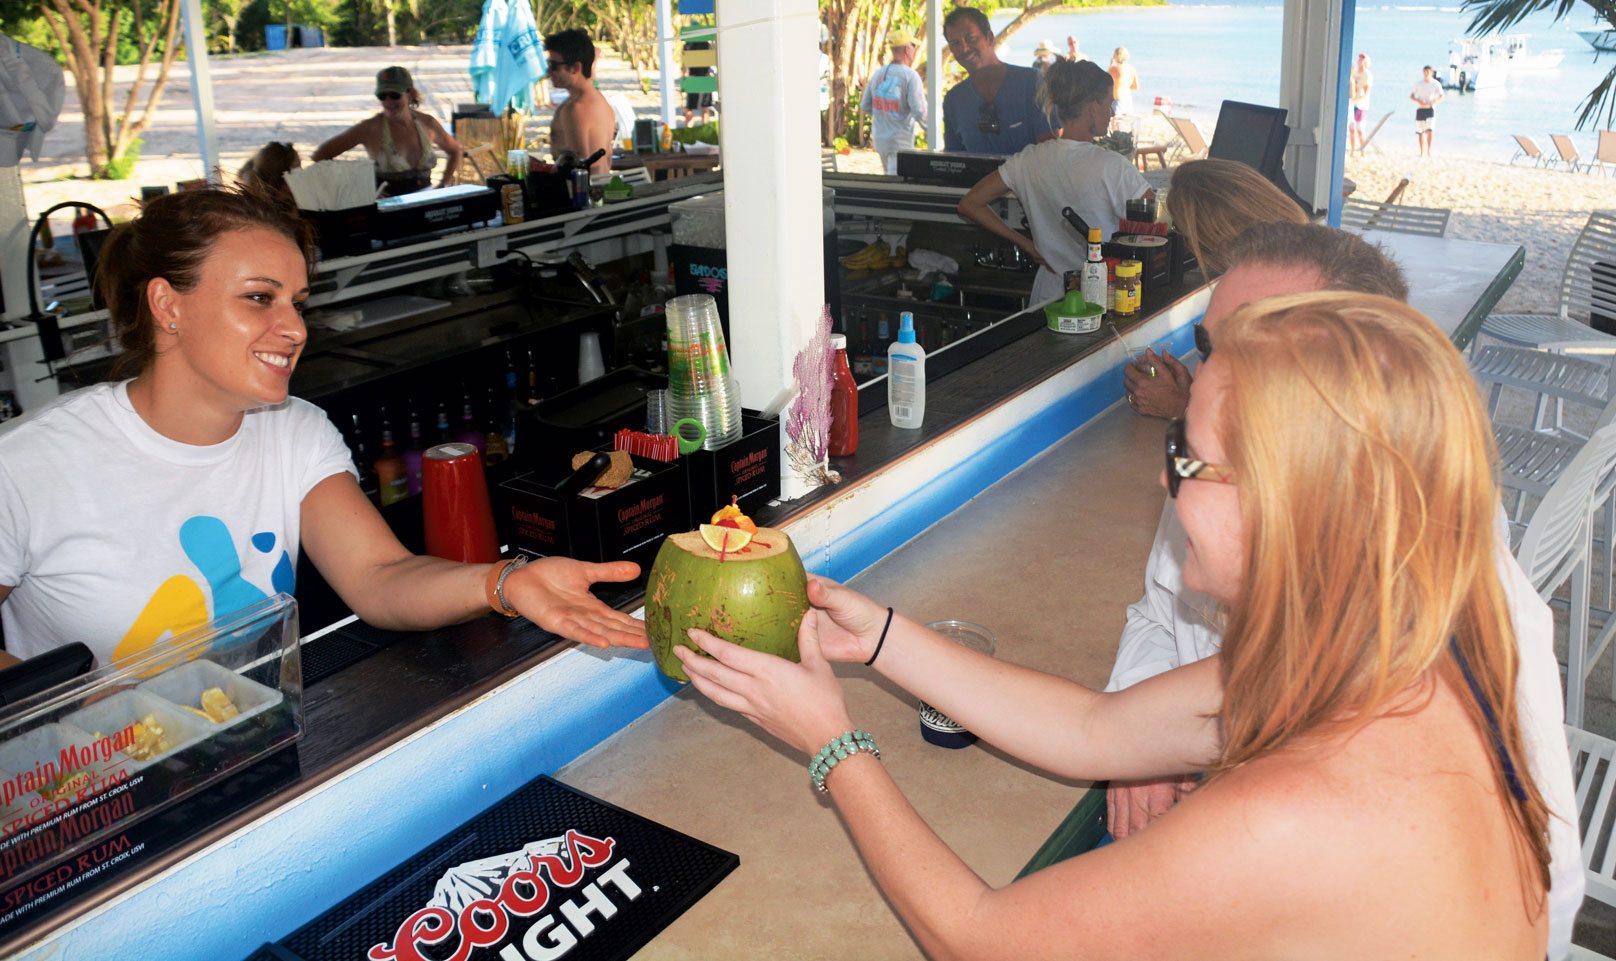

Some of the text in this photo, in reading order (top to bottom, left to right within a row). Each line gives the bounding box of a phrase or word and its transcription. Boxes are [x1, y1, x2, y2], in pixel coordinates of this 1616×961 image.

[30, 769, 100, 809] ORIGINAL
[58, 724, 136, 784] Morgan
[1, 767, 130, 837] SPICED RUM
[11, 830, 30, 845] WITH
[30, 815, 63, 836] PREMIUM
[63, 807, 79, 820] RUM
[79, 797, 99, 812] FROM
[129, 775, 144, 787] USVI
[59, 791, 135, 851] Morgan
[0, 834, 132, 914] SPICED RUM
[15, 901, 34, 916] WITH
[34, 884, 66, 906] PREMIUM
[66, 876, 82, 889] RUM
[82, 866, 101, 880] FROM
[130, 842, 145, 855] USVI
[367, 828, 617, 961] Coors
